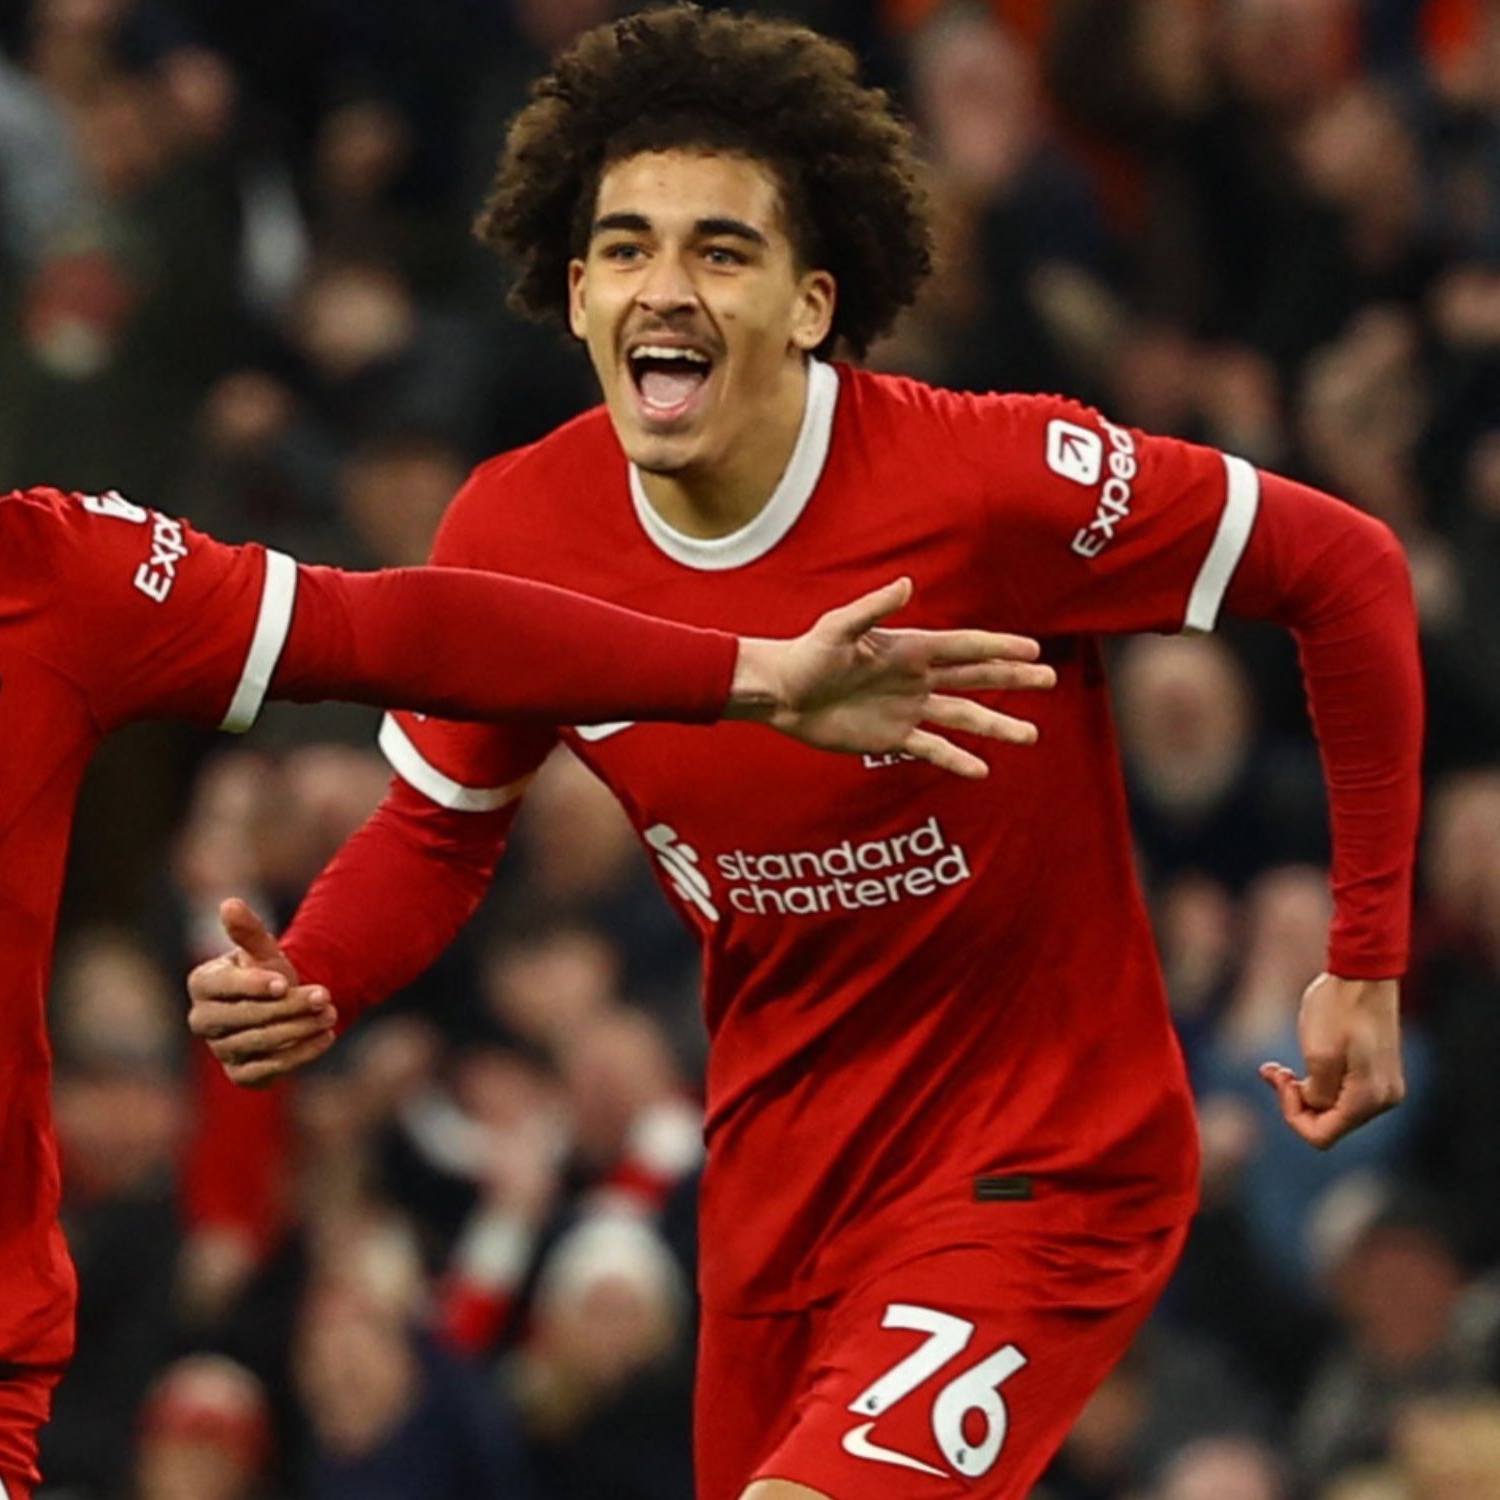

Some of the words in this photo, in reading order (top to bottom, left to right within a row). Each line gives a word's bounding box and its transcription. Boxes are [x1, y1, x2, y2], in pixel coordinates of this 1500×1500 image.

[717, 816, 944, 882] standard
[729, 844, 971, 914] chartered
[847, 1303, 1028, 1477] 76
